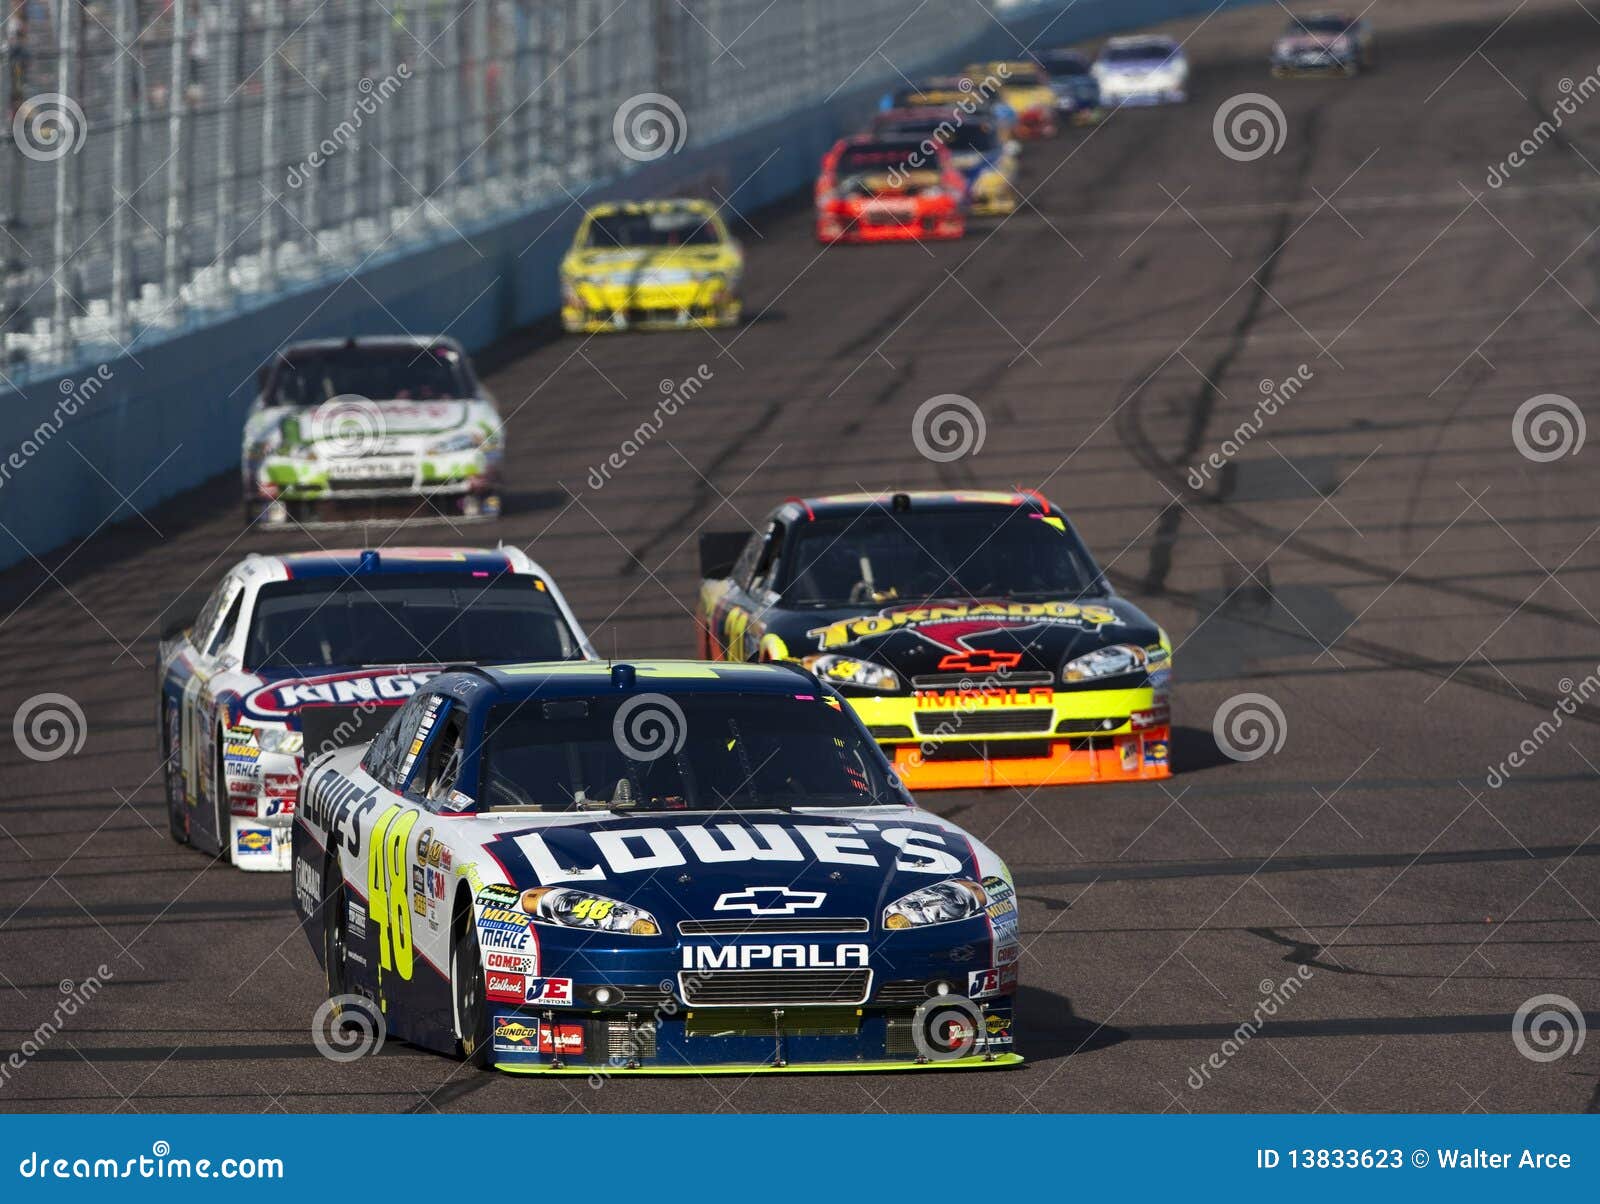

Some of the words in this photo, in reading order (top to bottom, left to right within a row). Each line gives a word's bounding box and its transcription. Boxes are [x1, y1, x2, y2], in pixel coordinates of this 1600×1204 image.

[809, 600, 1119, 650] TORNADOS
[915, 687, 1054, 708] IMPALA
[226, 761, 261, 778] MAHLE
[513, 823, 963, 886] LOWE'S
[367, 803, 420, 981] 48
[477, 898, 510, 909] BELTS
[572, 899, 614, 921] 48
[986, 898, 1012, 919] MOOG
[481, 906, 532, 926] MOOG
[481, 928, 530, 950] MAHLE
[488, 953, 522, 969] COMP
[683, 944, 869, 969] IMPALA
[488, 976, 523, 994] Edelbrock
[526, 978, 569, 1001] JE
[970, 970, 998, 996] JE
[495, 1027, 535, 1037] SUNOCO
